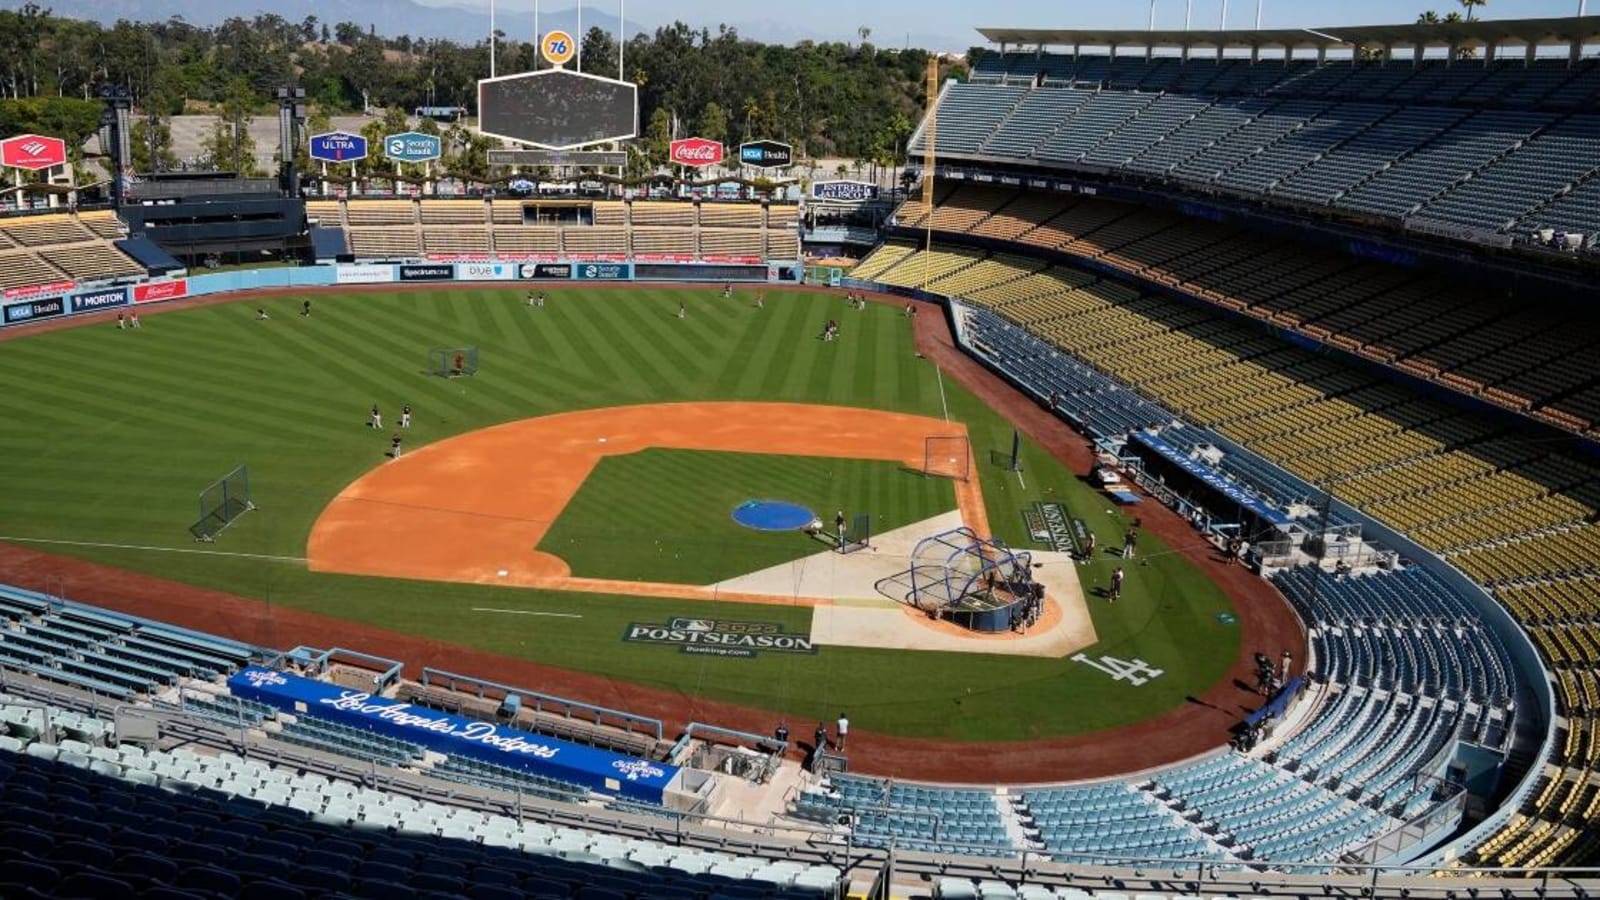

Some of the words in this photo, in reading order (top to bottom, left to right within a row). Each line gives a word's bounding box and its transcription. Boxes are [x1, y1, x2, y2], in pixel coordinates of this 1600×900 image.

[550, 41, 567, 54] 76
[322, 140, 355, 150] ULTRA
[764, 151, 789, 160] Health
[85, 292, 124, 307] MORTON
[34, 303, 60, 314] Health
[629, 626, 813, 650] POSTSEASON
[686, 646, 751, 656] Booking.com
[320, 691, 370, 711] Los
[361, 703, 457, 733] Angeles
[450, 722, 560, 758] Dodgers
